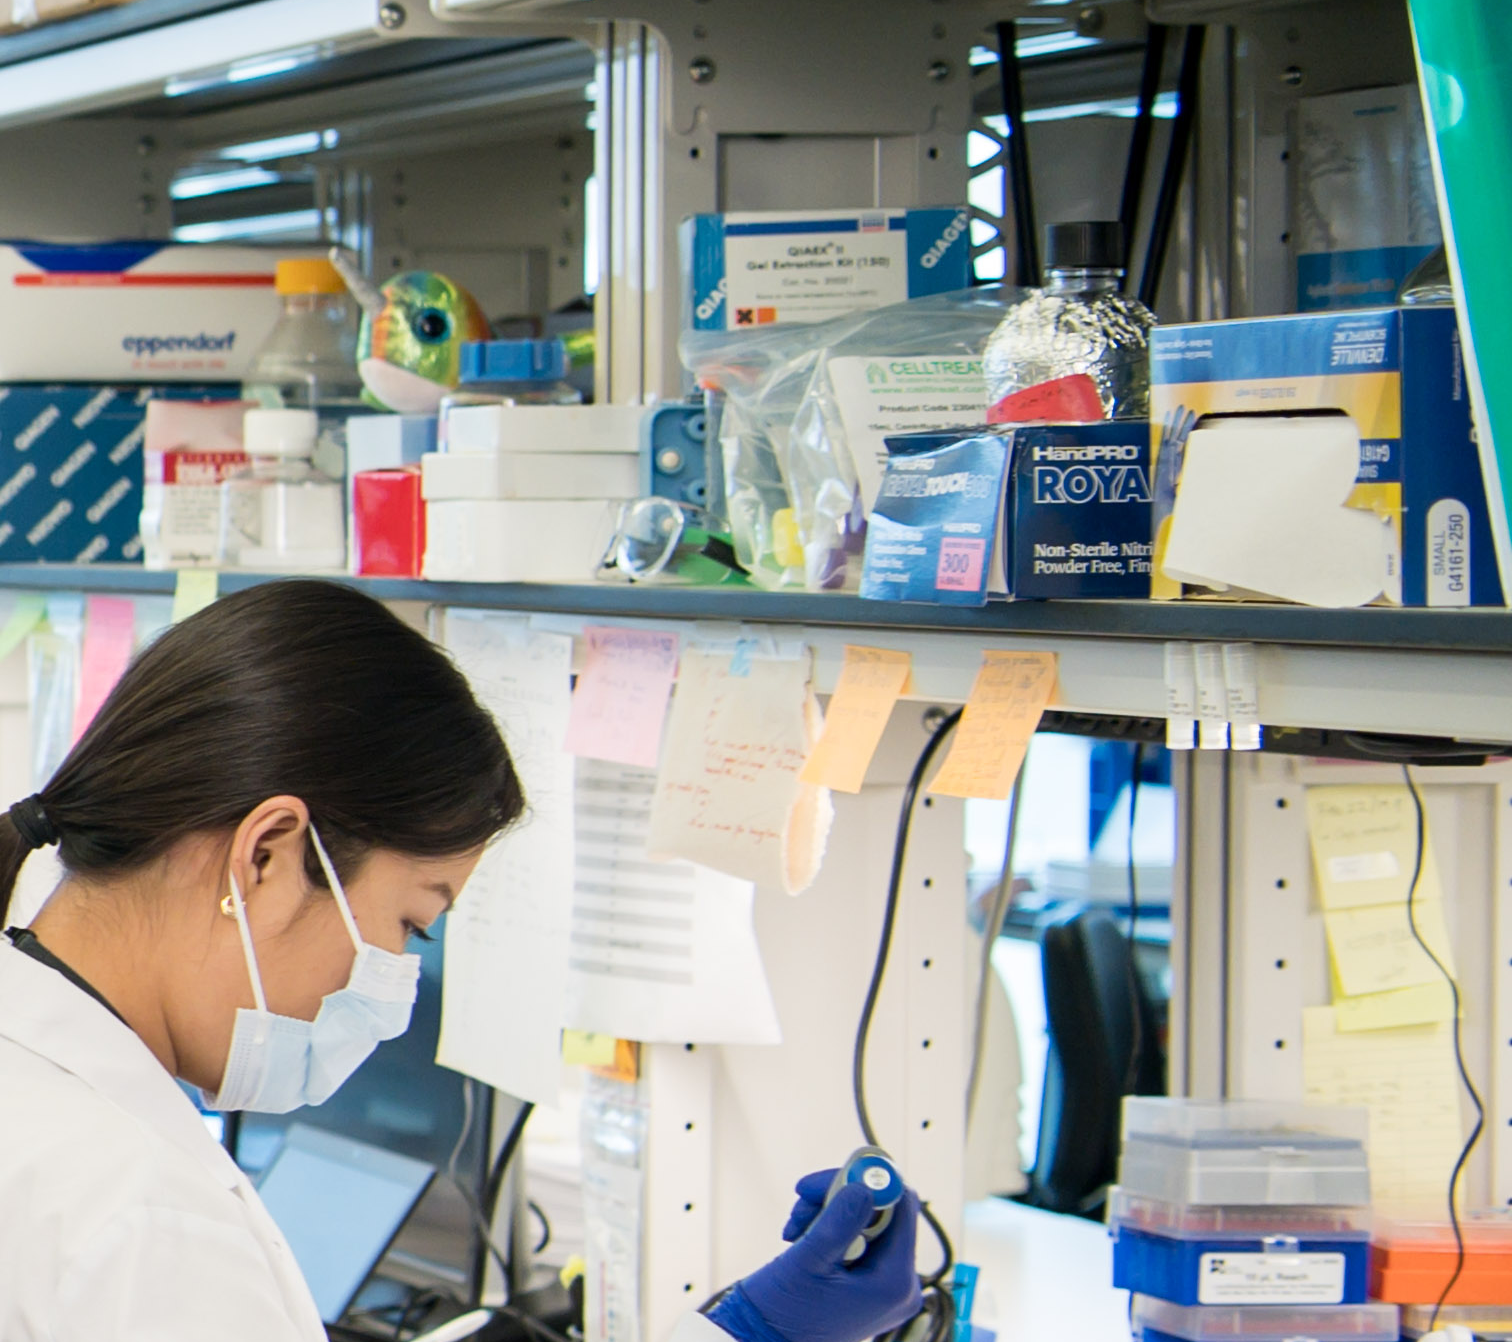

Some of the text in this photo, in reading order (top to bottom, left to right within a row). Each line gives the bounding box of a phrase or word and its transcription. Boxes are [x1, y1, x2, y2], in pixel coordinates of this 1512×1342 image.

[121, 330, 237, 356] eppendorf
[1032, 445, 1139, 461] HandPRO
[1033, 465, 1154, 504] ROYA
[1033, 542, 1119, 557] Non-Sterile
[1433, 530, 1447, 576] SMALL
[1448, 513, 1465, 593] G4161-250
[941, 553, 970, 574] 300
[1033, 559, 1090, 574] Powder
[1090, 558, 1126, 576] Free,
